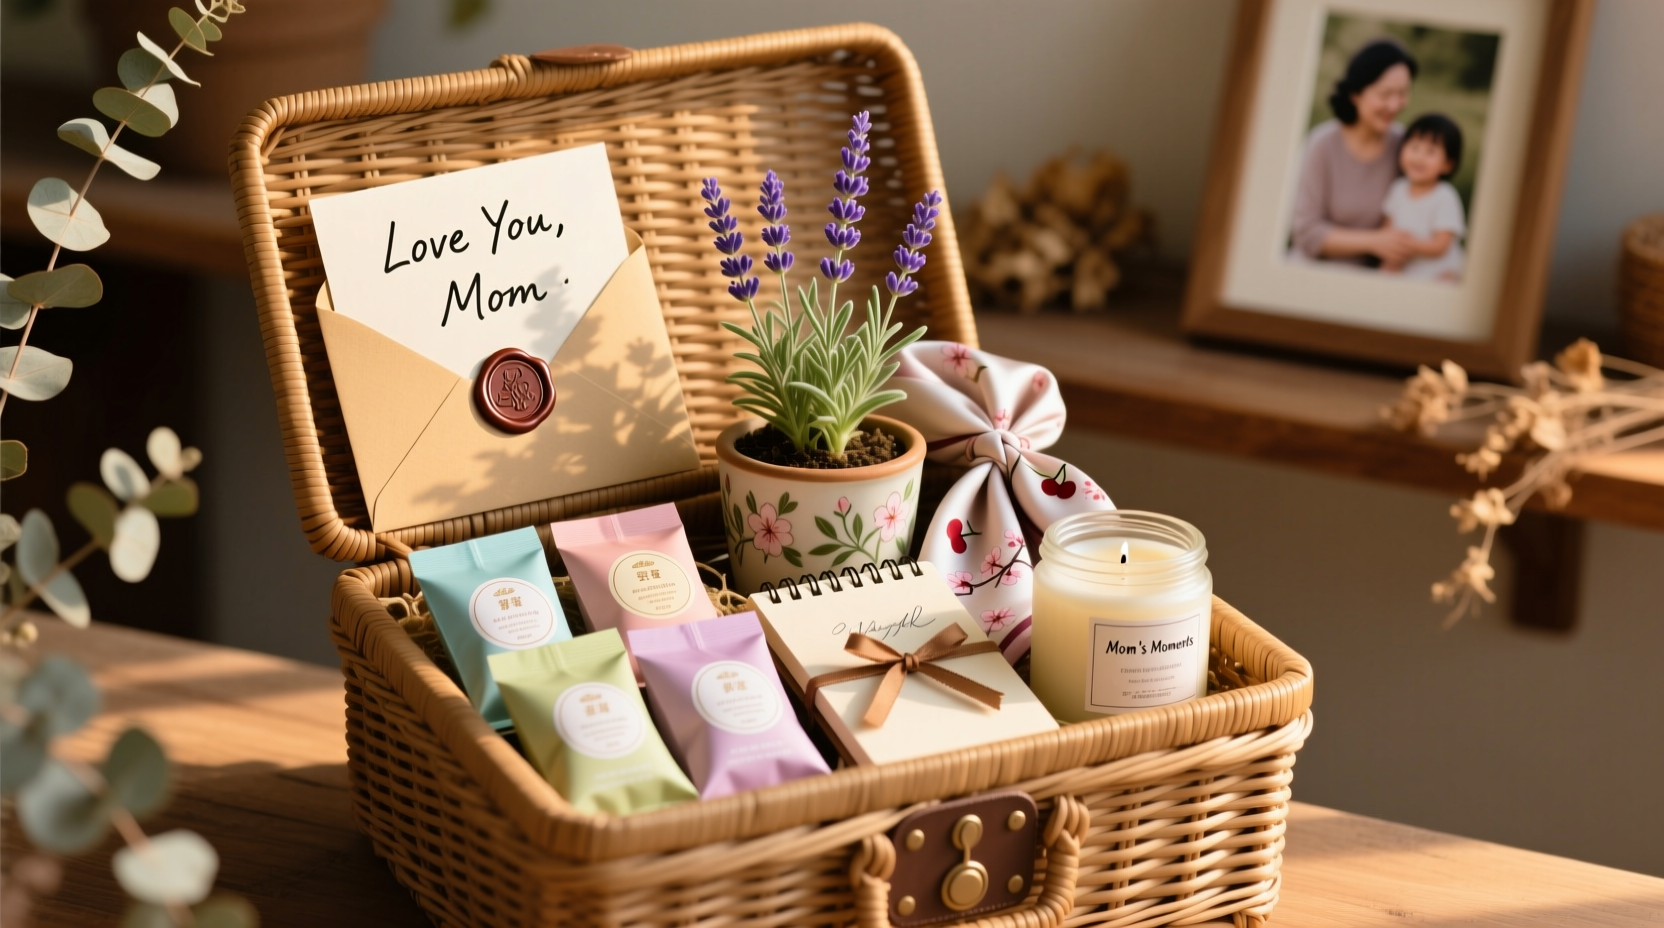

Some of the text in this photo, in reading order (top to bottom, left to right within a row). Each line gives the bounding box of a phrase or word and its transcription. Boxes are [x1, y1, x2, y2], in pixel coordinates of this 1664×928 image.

[384, 199, 565, 274] Love You,
[1105, 640, 1147, 655] Mom's
